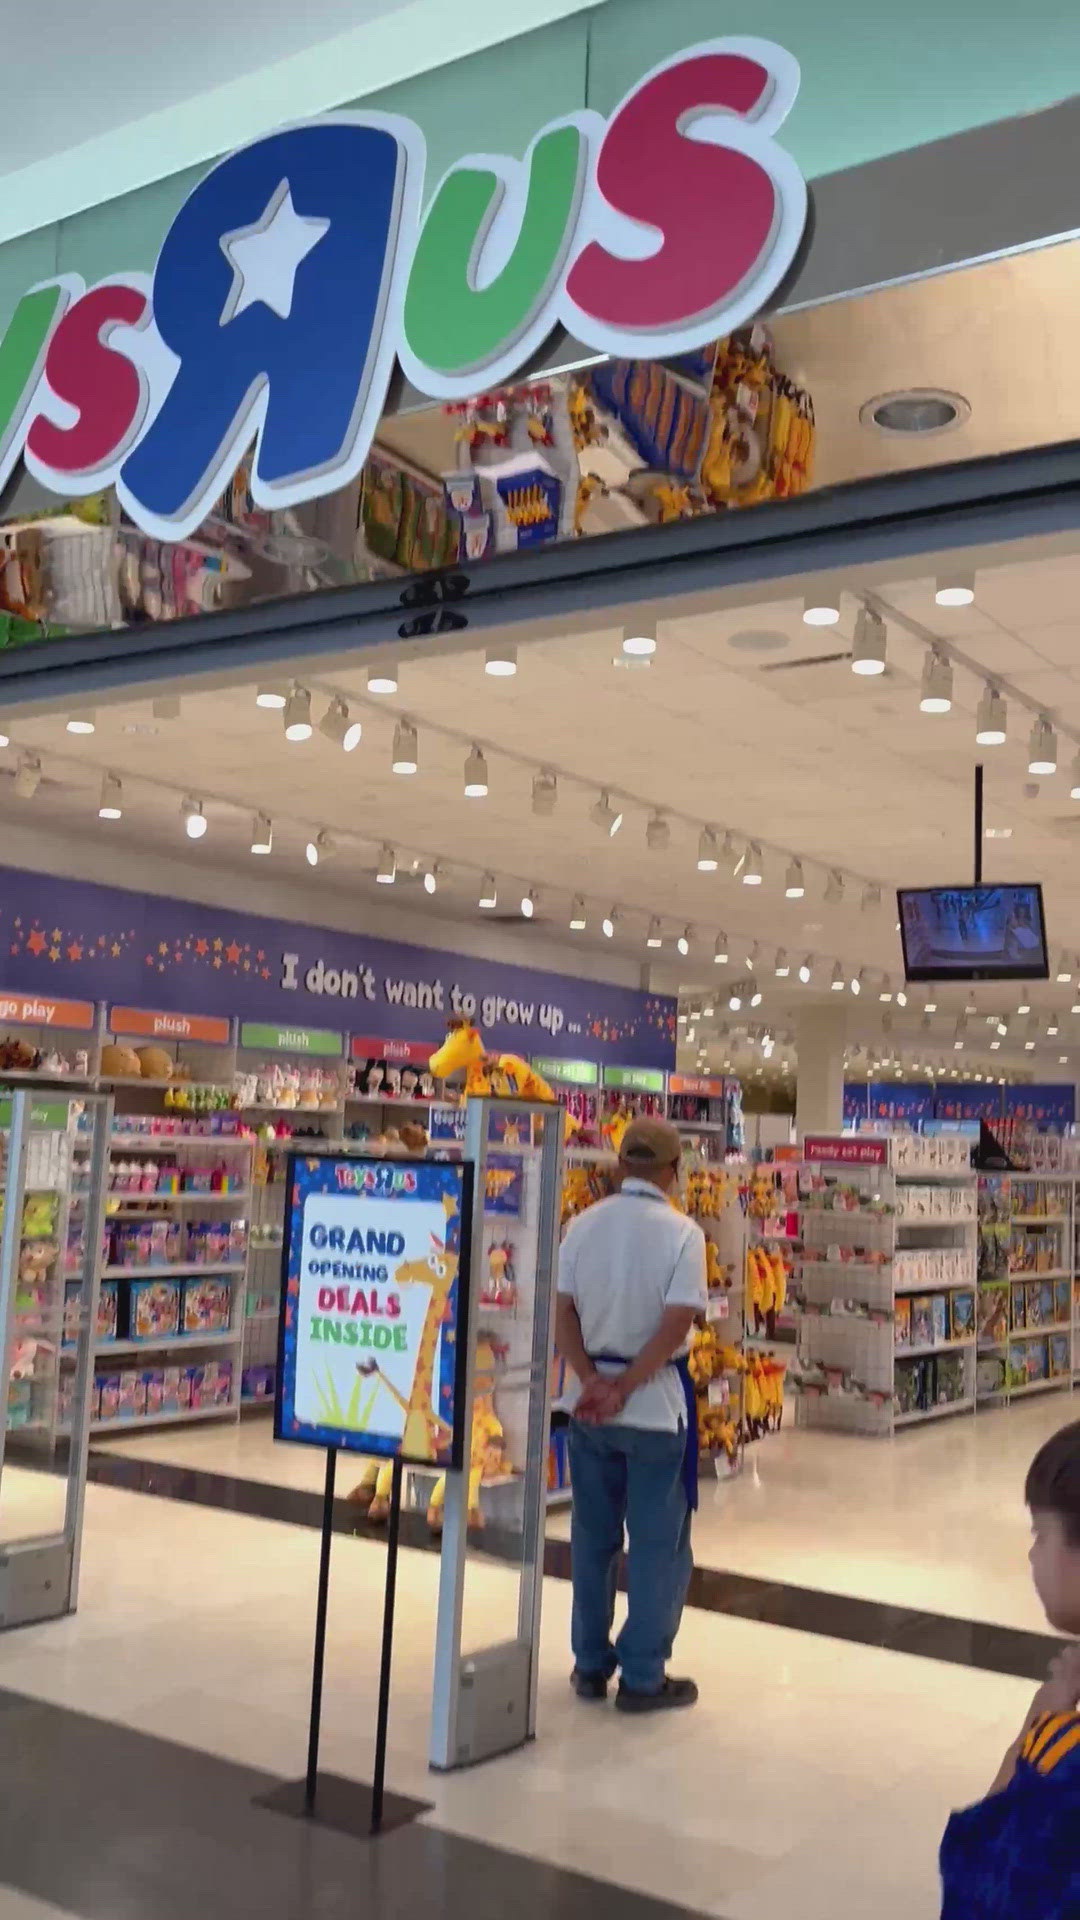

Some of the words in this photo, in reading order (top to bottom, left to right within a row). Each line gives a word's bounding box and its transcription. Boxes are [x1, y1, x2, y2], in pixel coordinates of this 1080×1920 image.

[282, 953, 299, 990] I
[306, 959, 376, 1001] don't
[385, 977, 444, 1011] want
[451, 984, 477, 1017] to
[482, 996, 534, 1028] grow
[22, 1000, 56, 1023] play
[154, 1015, 191, 1036] plush
[278, 1031, 309, 1048] plush
[383, 1041, 411, 1058] plush
[309, 1222, 406, 1257] GRAND
[308, 1259, 389, 1284] OPENING
[318, 1284, 401, 1319] DEALS
[309, 1316, 408, 1352] INSIDE
